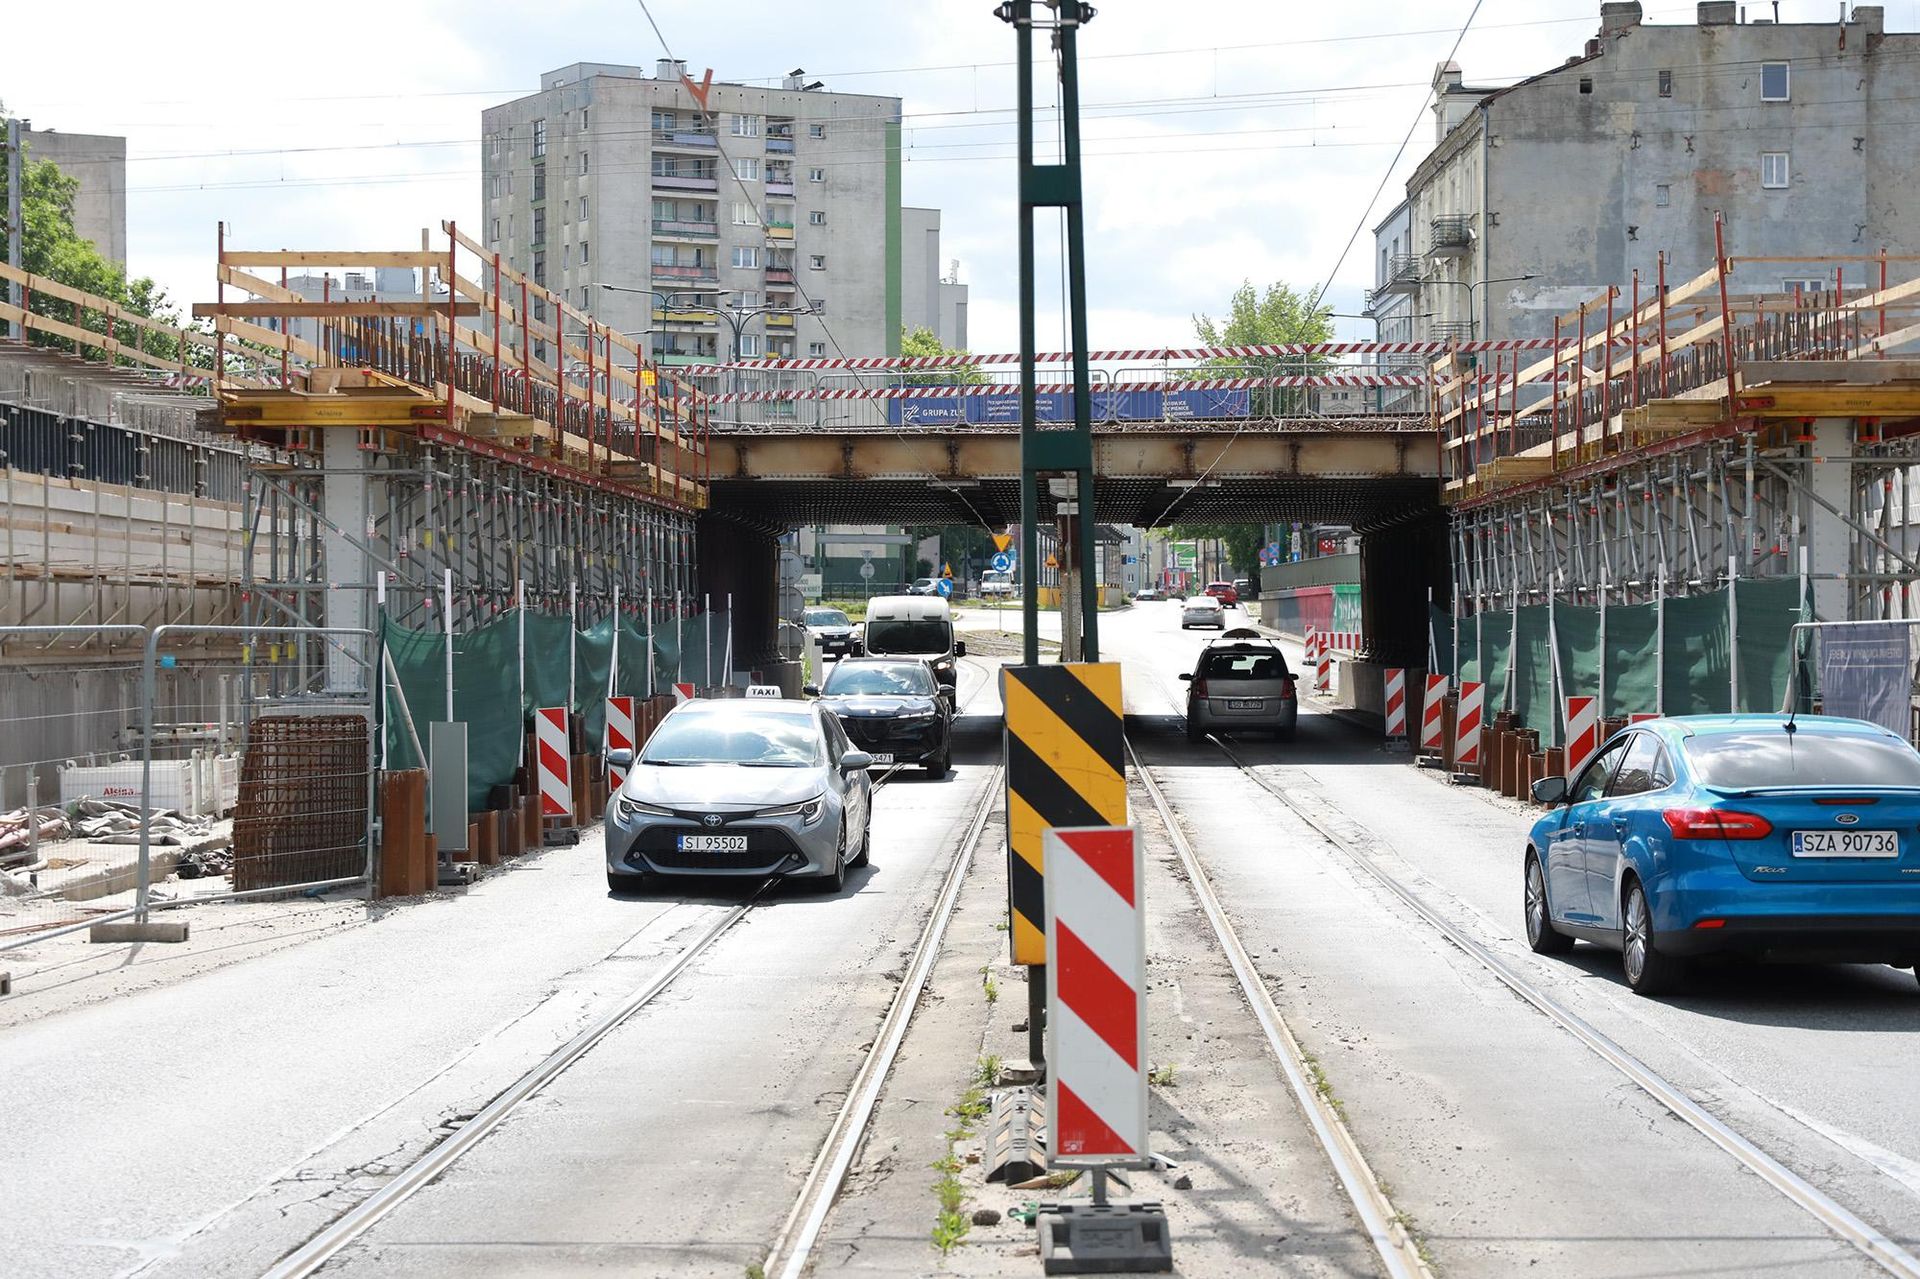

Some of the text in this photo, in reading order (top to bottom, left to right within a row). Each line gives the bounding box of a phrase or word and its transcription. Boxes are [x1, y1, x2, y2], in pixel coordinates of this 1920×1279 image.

[751, 688, 776, 696] TAXI
[103, 787, 134, 797] Alsina
[685, 837, 699, 849] SI
[705, 837, 744, 850] 95502
[1804, 834, 1895, 852] SZA 90736
